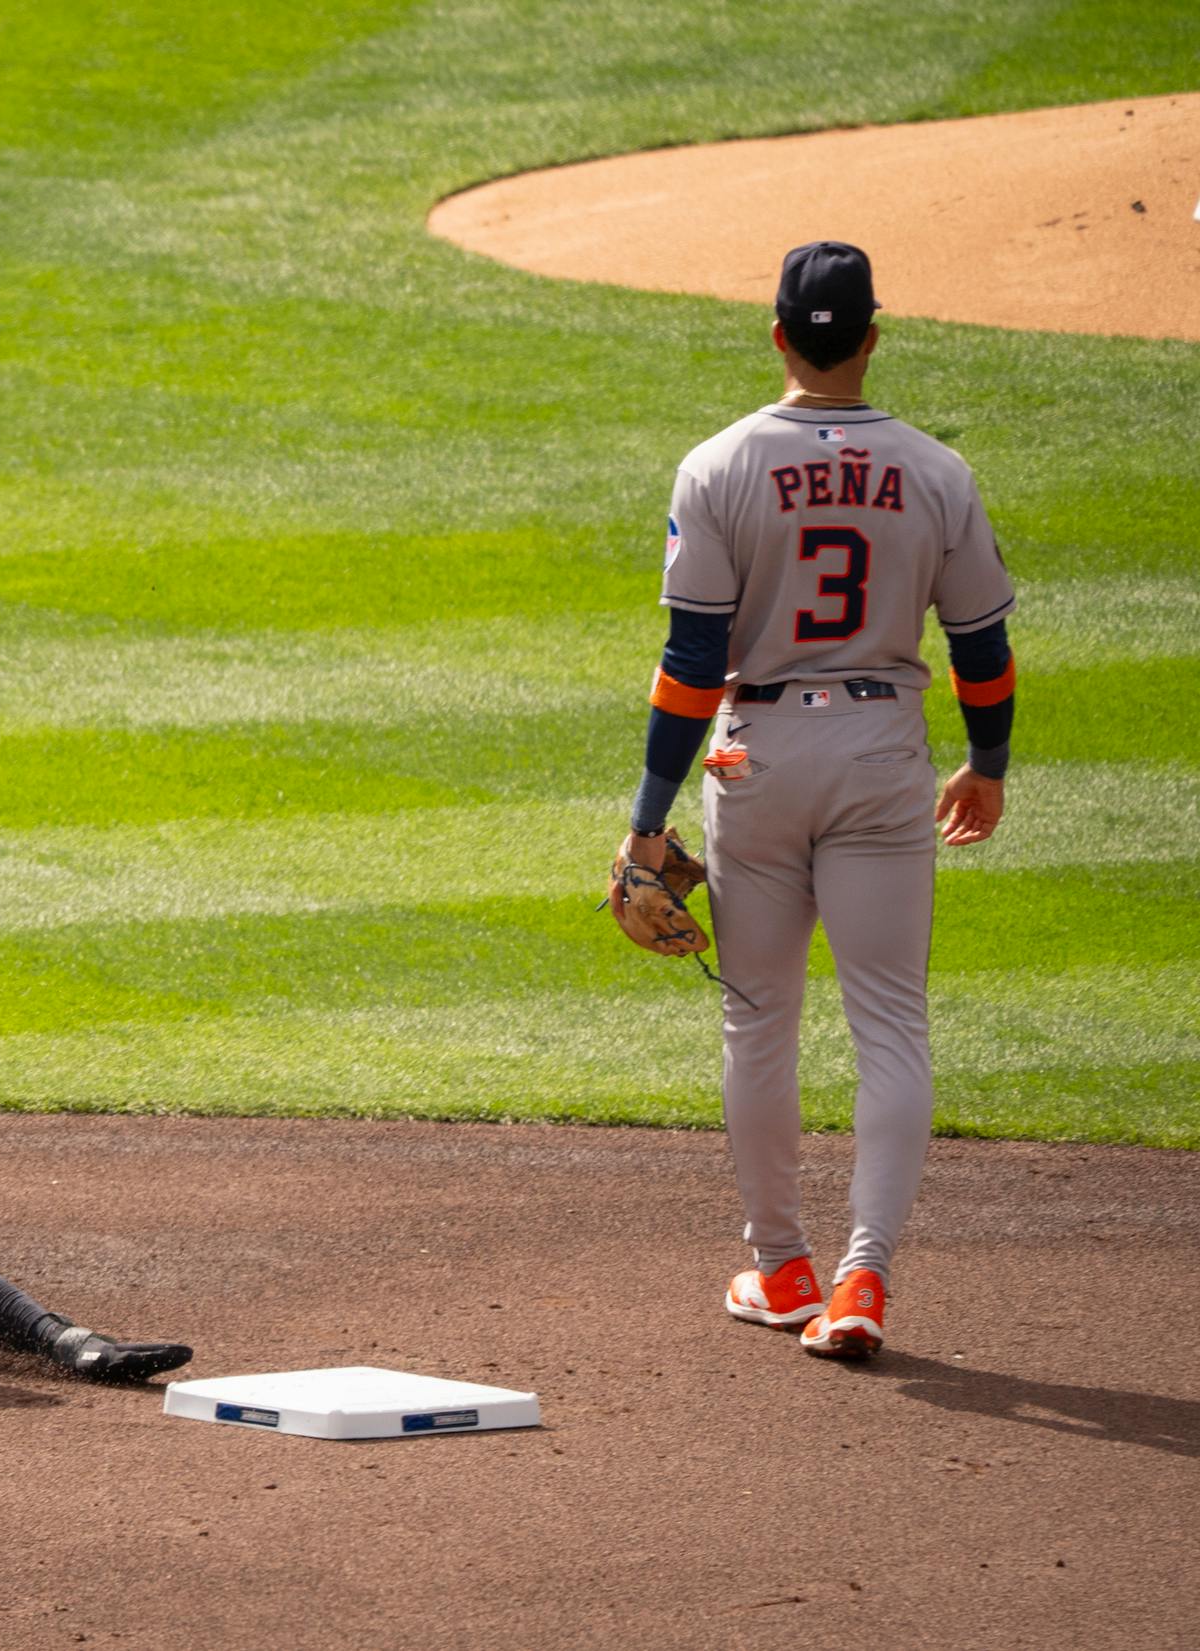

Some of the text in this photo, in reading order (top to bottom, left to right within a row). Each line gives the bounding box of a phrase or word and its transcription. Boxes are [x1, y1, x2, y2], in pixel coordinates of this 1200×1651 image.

[770, 447, 905, 513] PEÑA
[794, 526, 871, 643] 3
[795, 1275, 812, 1296] 3
[857, 1288, 874, 1308] 3
